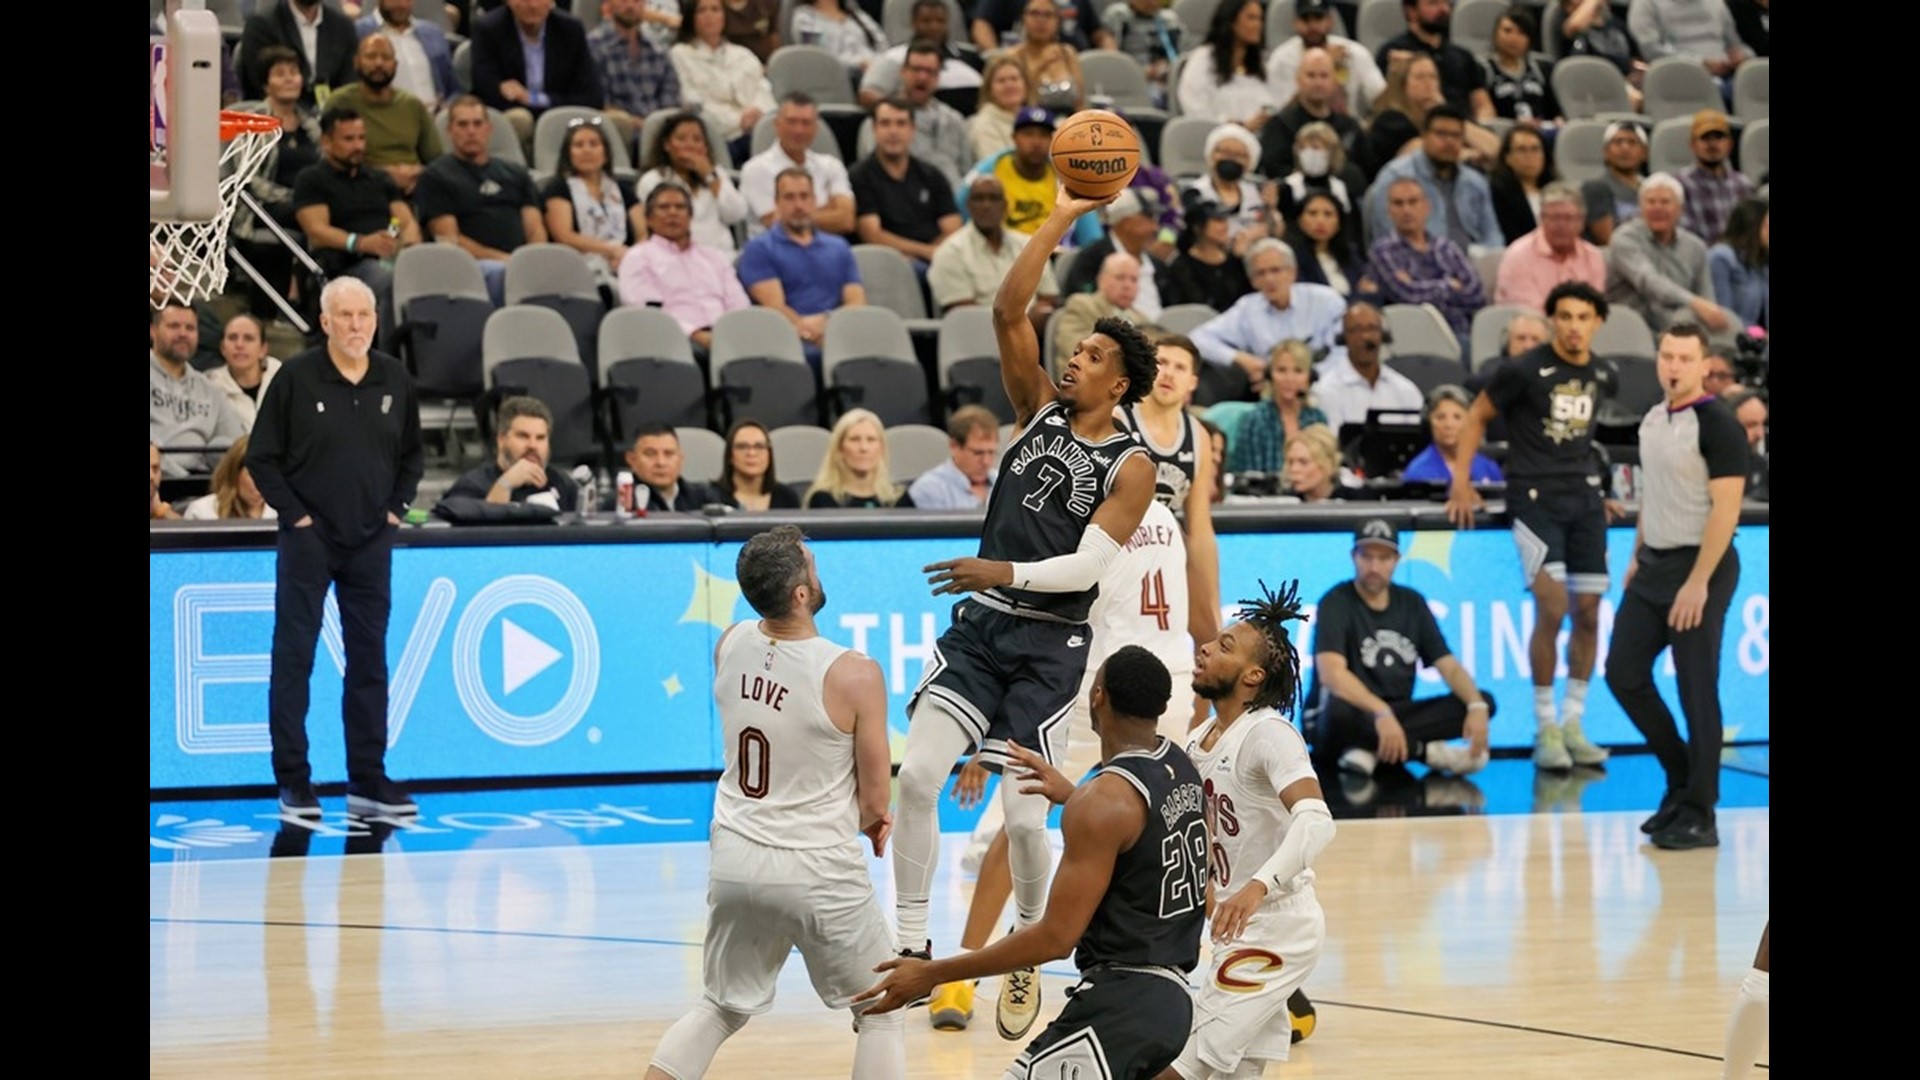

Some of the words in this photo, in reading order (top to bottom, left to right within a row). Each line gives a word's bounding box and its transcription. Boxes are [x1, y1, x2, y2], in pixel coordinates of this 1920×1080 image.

[1068, 157, 1127, 175] Wilson
[1553, 395, 1593, 420] 50
[1010, 434, 1045, 475] SAN
[1046, 435, 1097, 517] ANTONIO
[1022, 463, 1066, 512] 7
[1140, 567, 1170, 631] 4
[839, 612, 936, 695] TH
[741, 673, 789, 712] LOVE
[738, 726, 770, 799] 0
[1160, 783, 1203, 831] BASSEY
[1159, 818, 1209, 918] 28
[1209, 842, 1231, 887] 0
